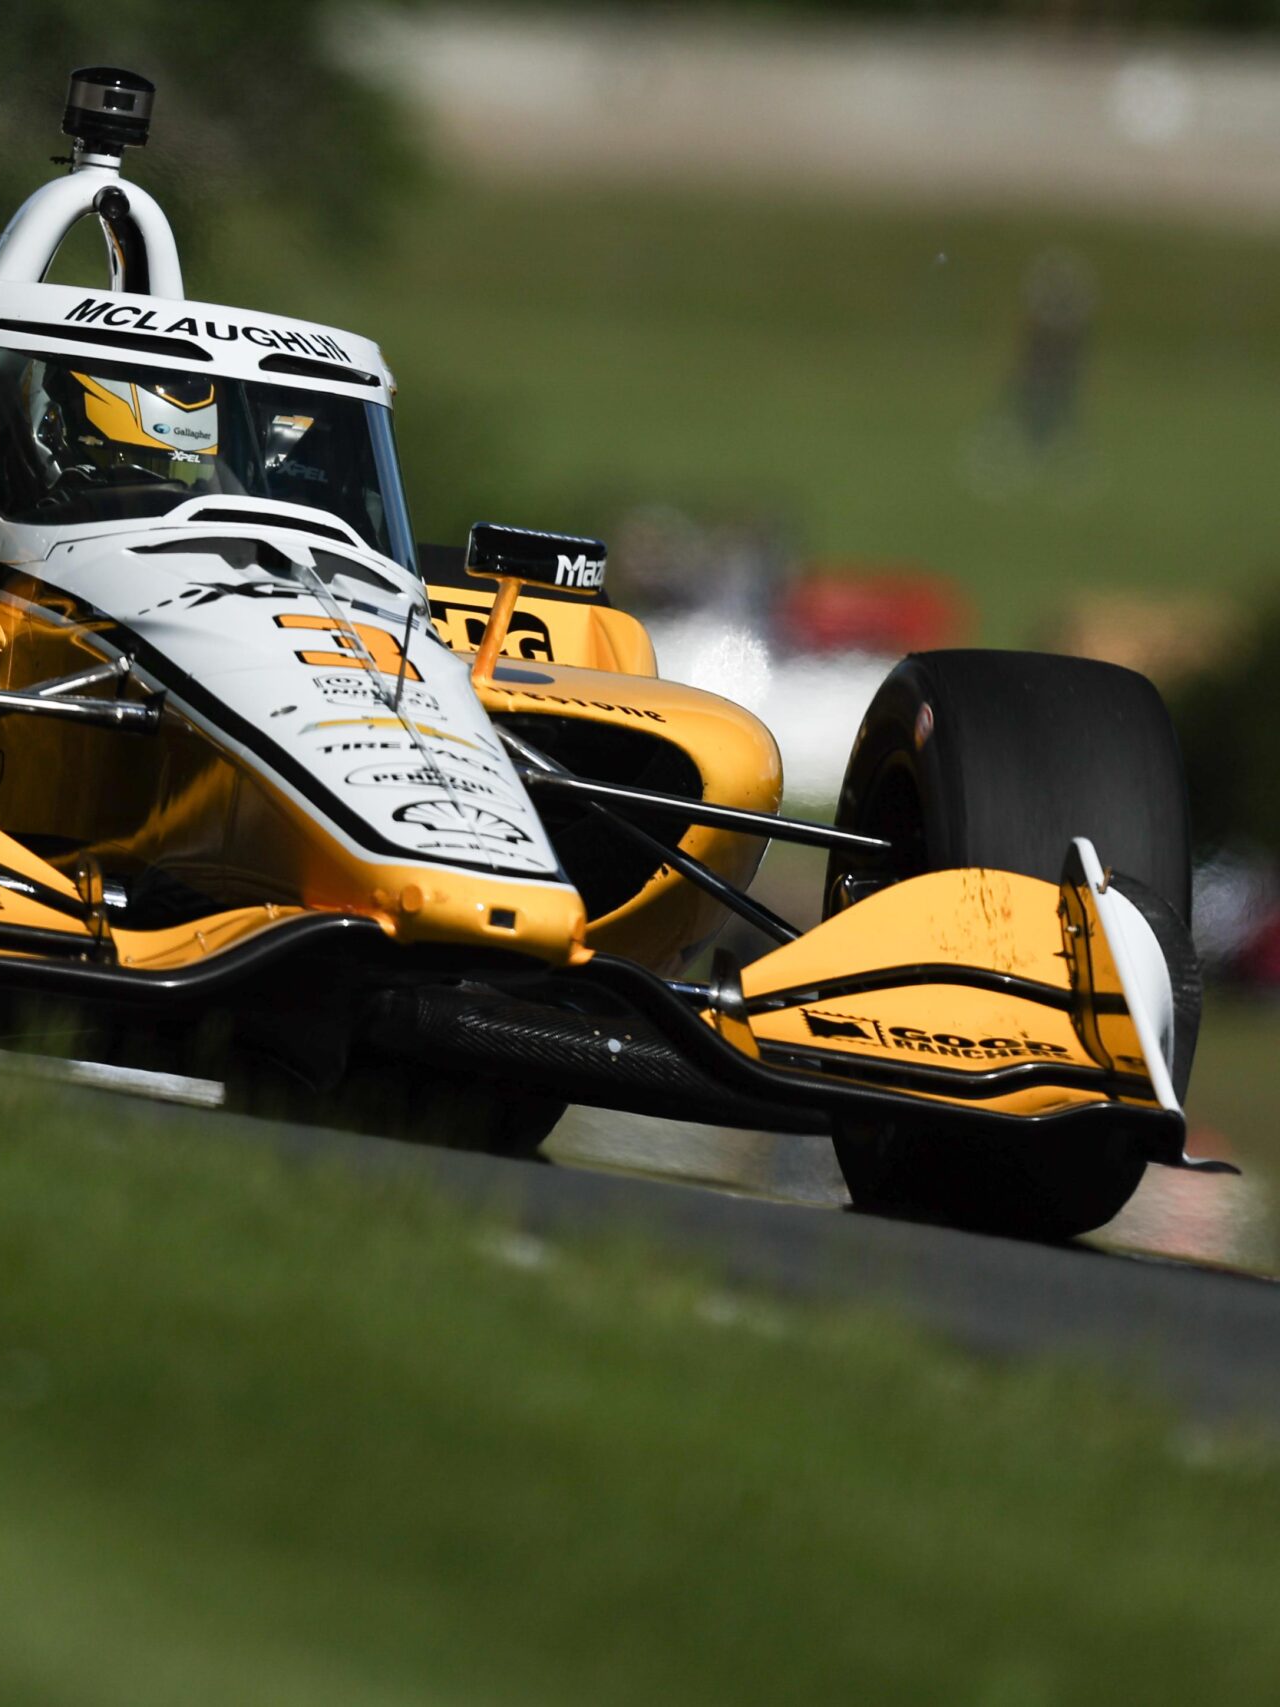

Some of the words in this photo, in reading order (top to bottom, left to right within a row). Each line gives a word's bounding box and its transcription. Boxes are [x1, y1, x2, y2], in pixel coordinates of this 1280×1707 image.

[65, 298, 352, 363] MCLAUGHLIN
[173, 427, 211, 440] Gallagher
[171, 450, 200, 463] XPEL
[554, 554, 606, 590] Maz
[272, 613, 426, 683] 3
[888, 1026, 1069, 1054] GOOD
